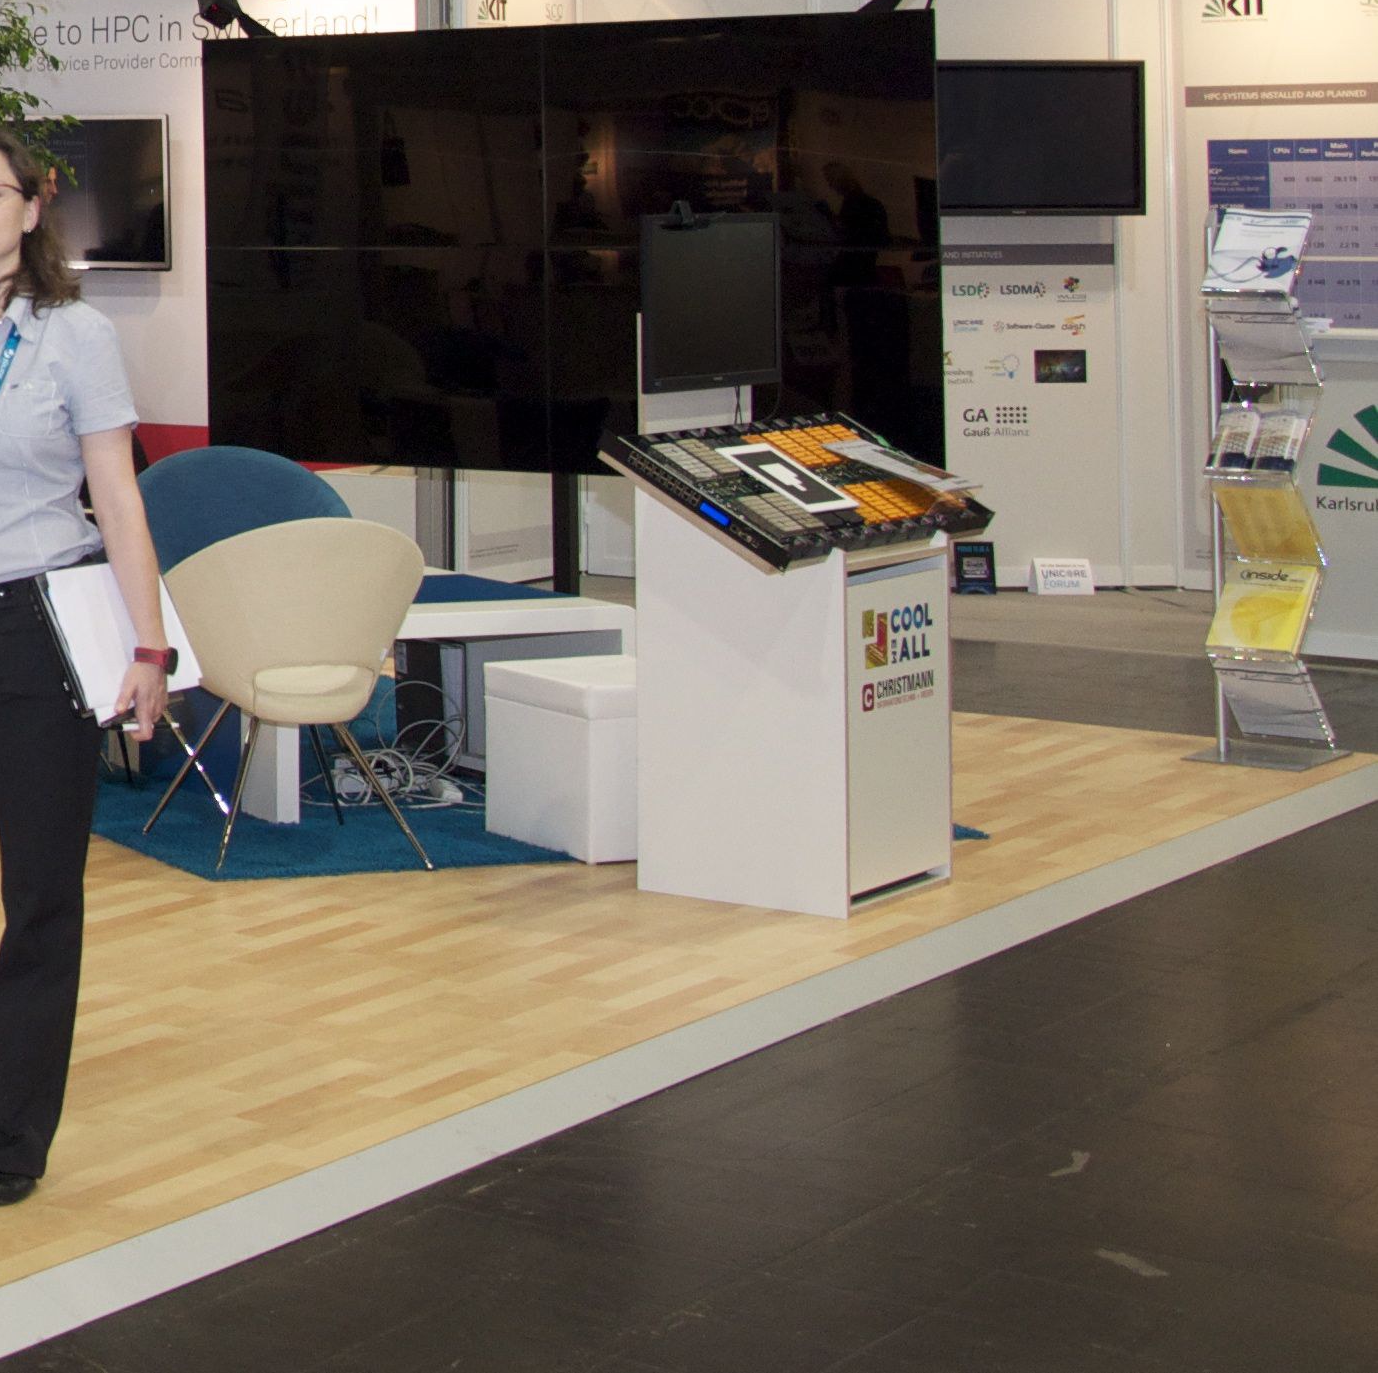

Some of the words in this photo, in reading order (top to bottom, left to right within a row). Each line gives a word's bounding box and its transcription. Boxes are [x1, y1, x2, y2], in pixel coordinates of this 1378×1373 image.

[56, 20, 82, 46] to
[91, 14, 150, 45] HPC
[158, 14, 182, 42] in
[94, 55, 156, 71] Provider
[952, 284, 985, 296] LSDF
[1000, 284, 1041, 296] LSDMA
[962, 408, 989, 423] GA
[890, 602, 933, 633] COOL
[899, 632, 930, 662] ALL
[876, 669, 934, 699] CHRISTMANN
